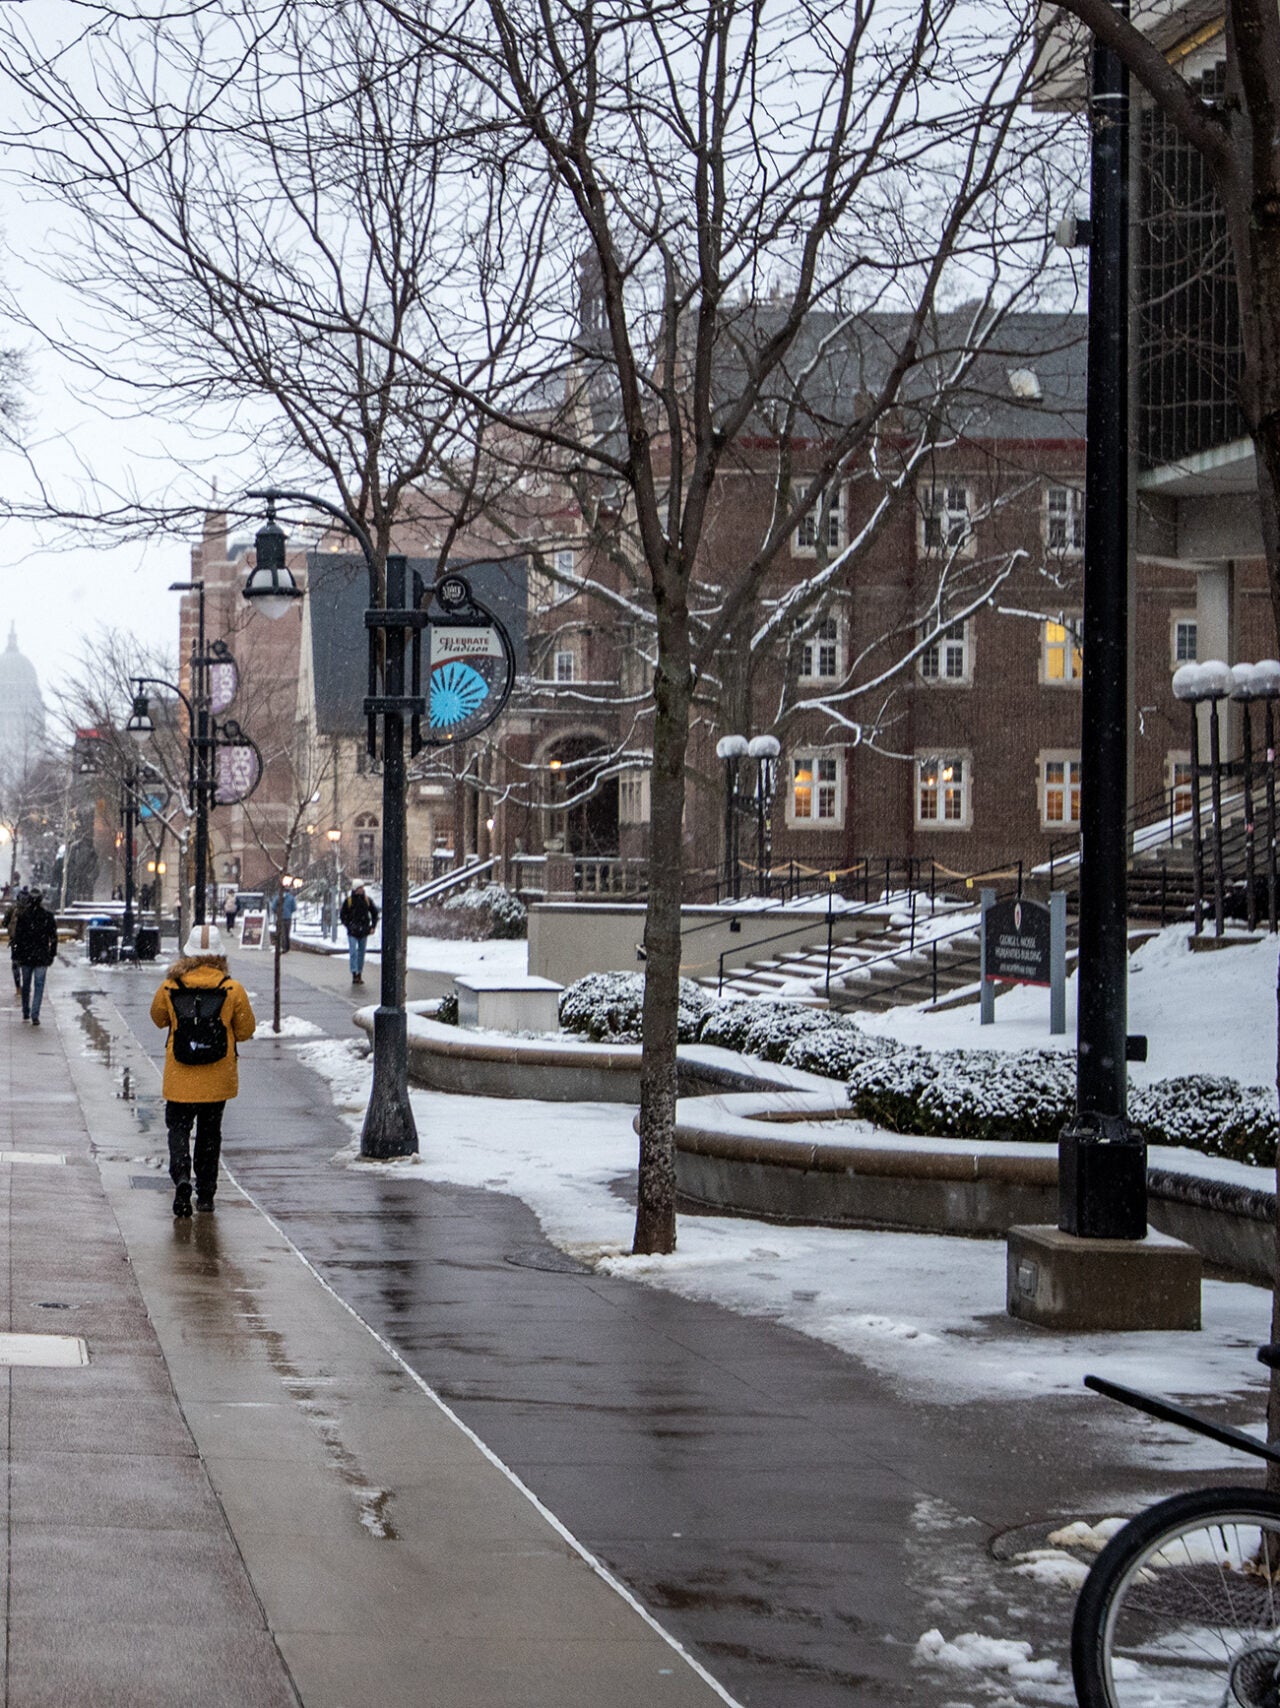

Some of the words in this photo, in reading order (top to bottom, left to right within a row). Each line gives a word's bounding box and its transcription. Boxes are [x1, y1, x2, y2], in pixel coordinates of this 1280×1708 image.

[436, 638, 488, 652] Madison
[439, 637, 489, 645] CELEBRATE
[1020, 949, 1042, 962] BUILDING
